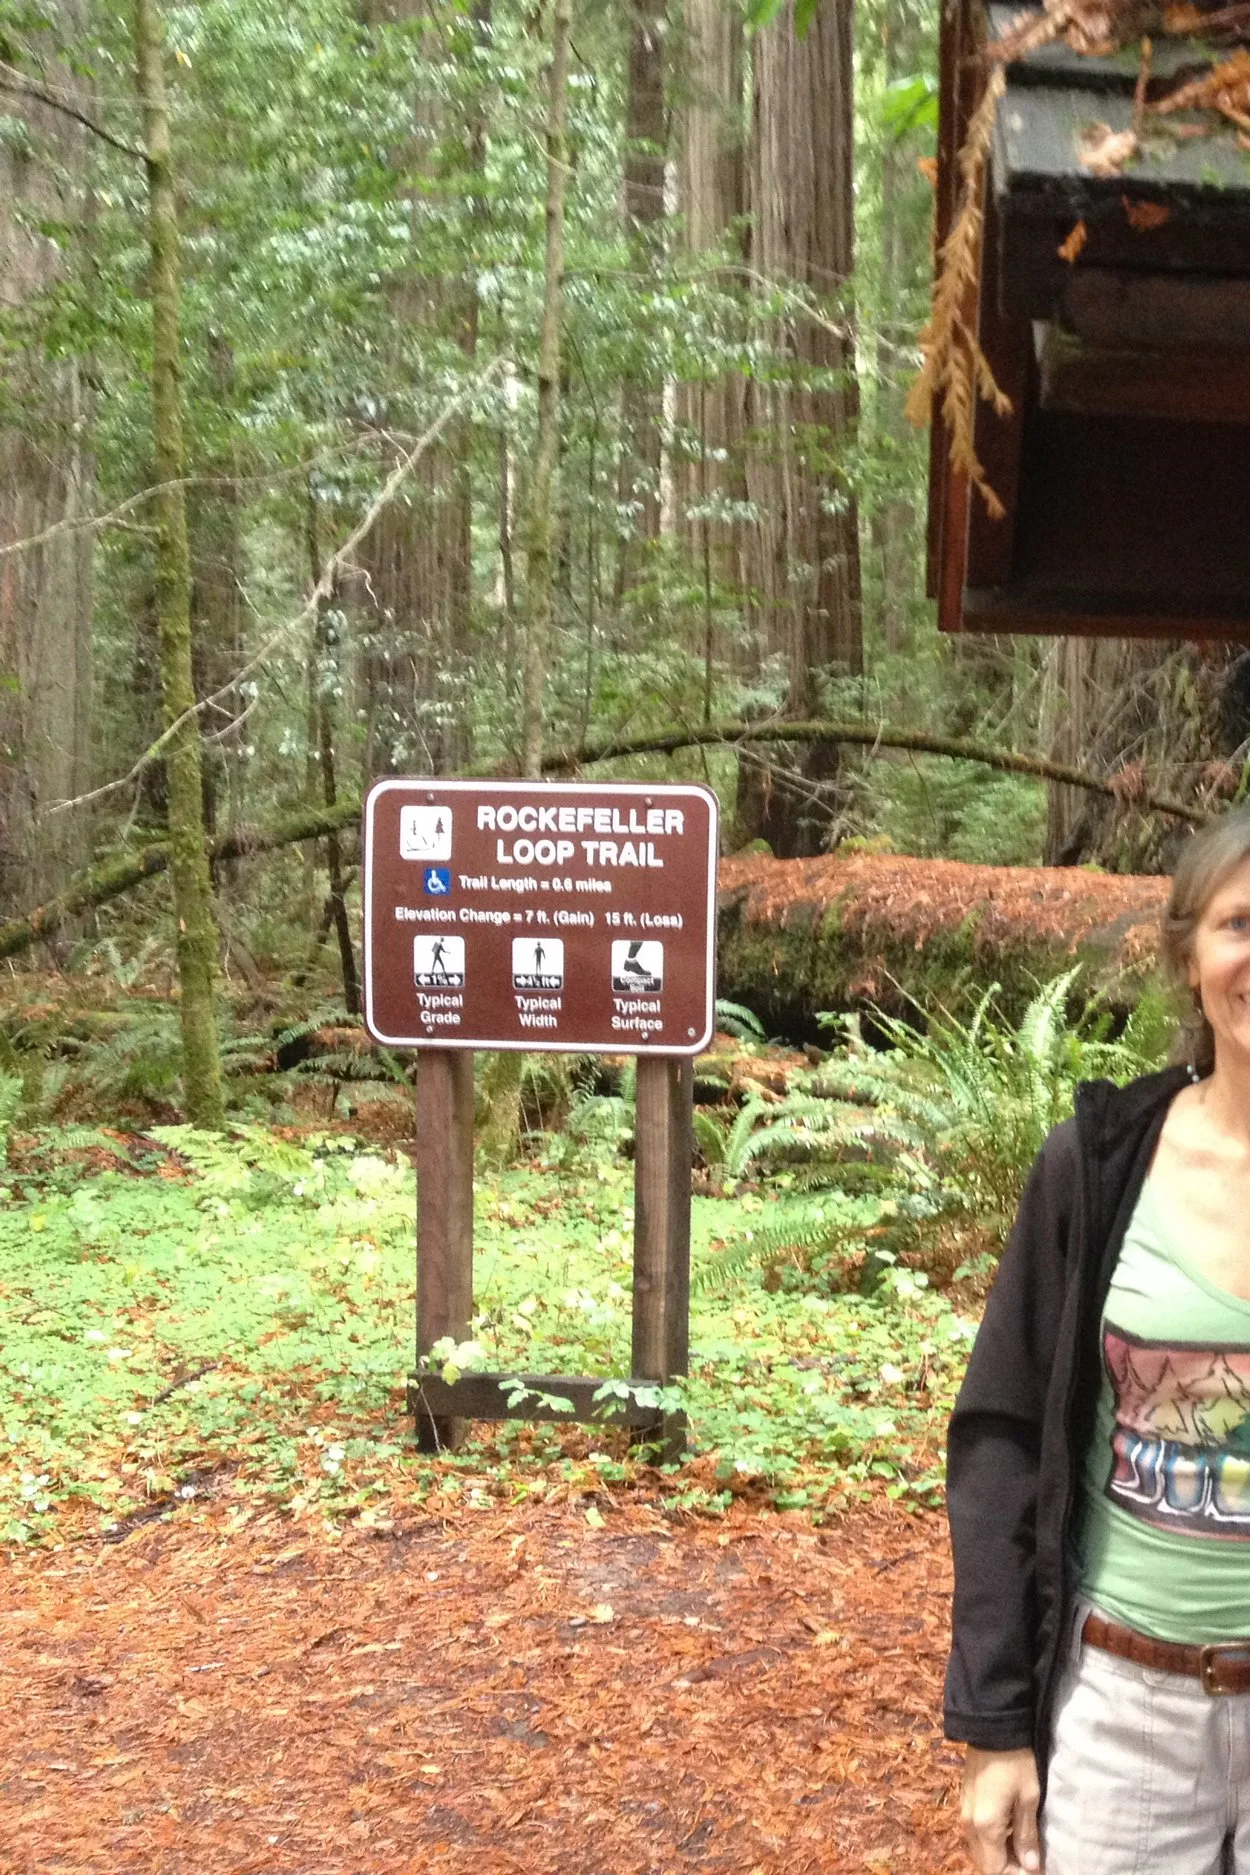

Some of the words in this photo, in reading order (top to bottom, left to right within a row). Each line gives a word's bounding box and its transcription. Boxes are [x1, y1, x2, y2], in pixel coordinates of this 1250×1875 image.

[476, 805, 686, 834] ROCKEFELLER
[496, 839, 576, 865] LOOP
[580, 840, 664, 868] TRAIL
[458, 875, 488, 890] Trail
[491, 876, 538, 894] Length
[540, 881, 550, 890] =
[552, 878, 573, 891] 0.6
[576, 879, 612, 893] miles
[395, 907, 456, 921] Elevation
[459, 908, 511, 925] Change
[513, 913, 522, 922] =
[525, 910, 535, 923] 7
[537, 911, 550, 924] ft.
[553, 911, 595, 928] (Gain)
[605, 912, 621, 926] 15
[624, 913, 637, 926] ft.
[640, 913, 684, 930] (Loss)
[417, 993, 464, 1008] Typical
[515, 996, 562, 1011] Typical
[613, 999, 661, 1014] Typical
[420, 1011, 461, 1025] Grade
[519, 1014, 557, 1028] Width
[611, 1016, 663, 1031] Surface
